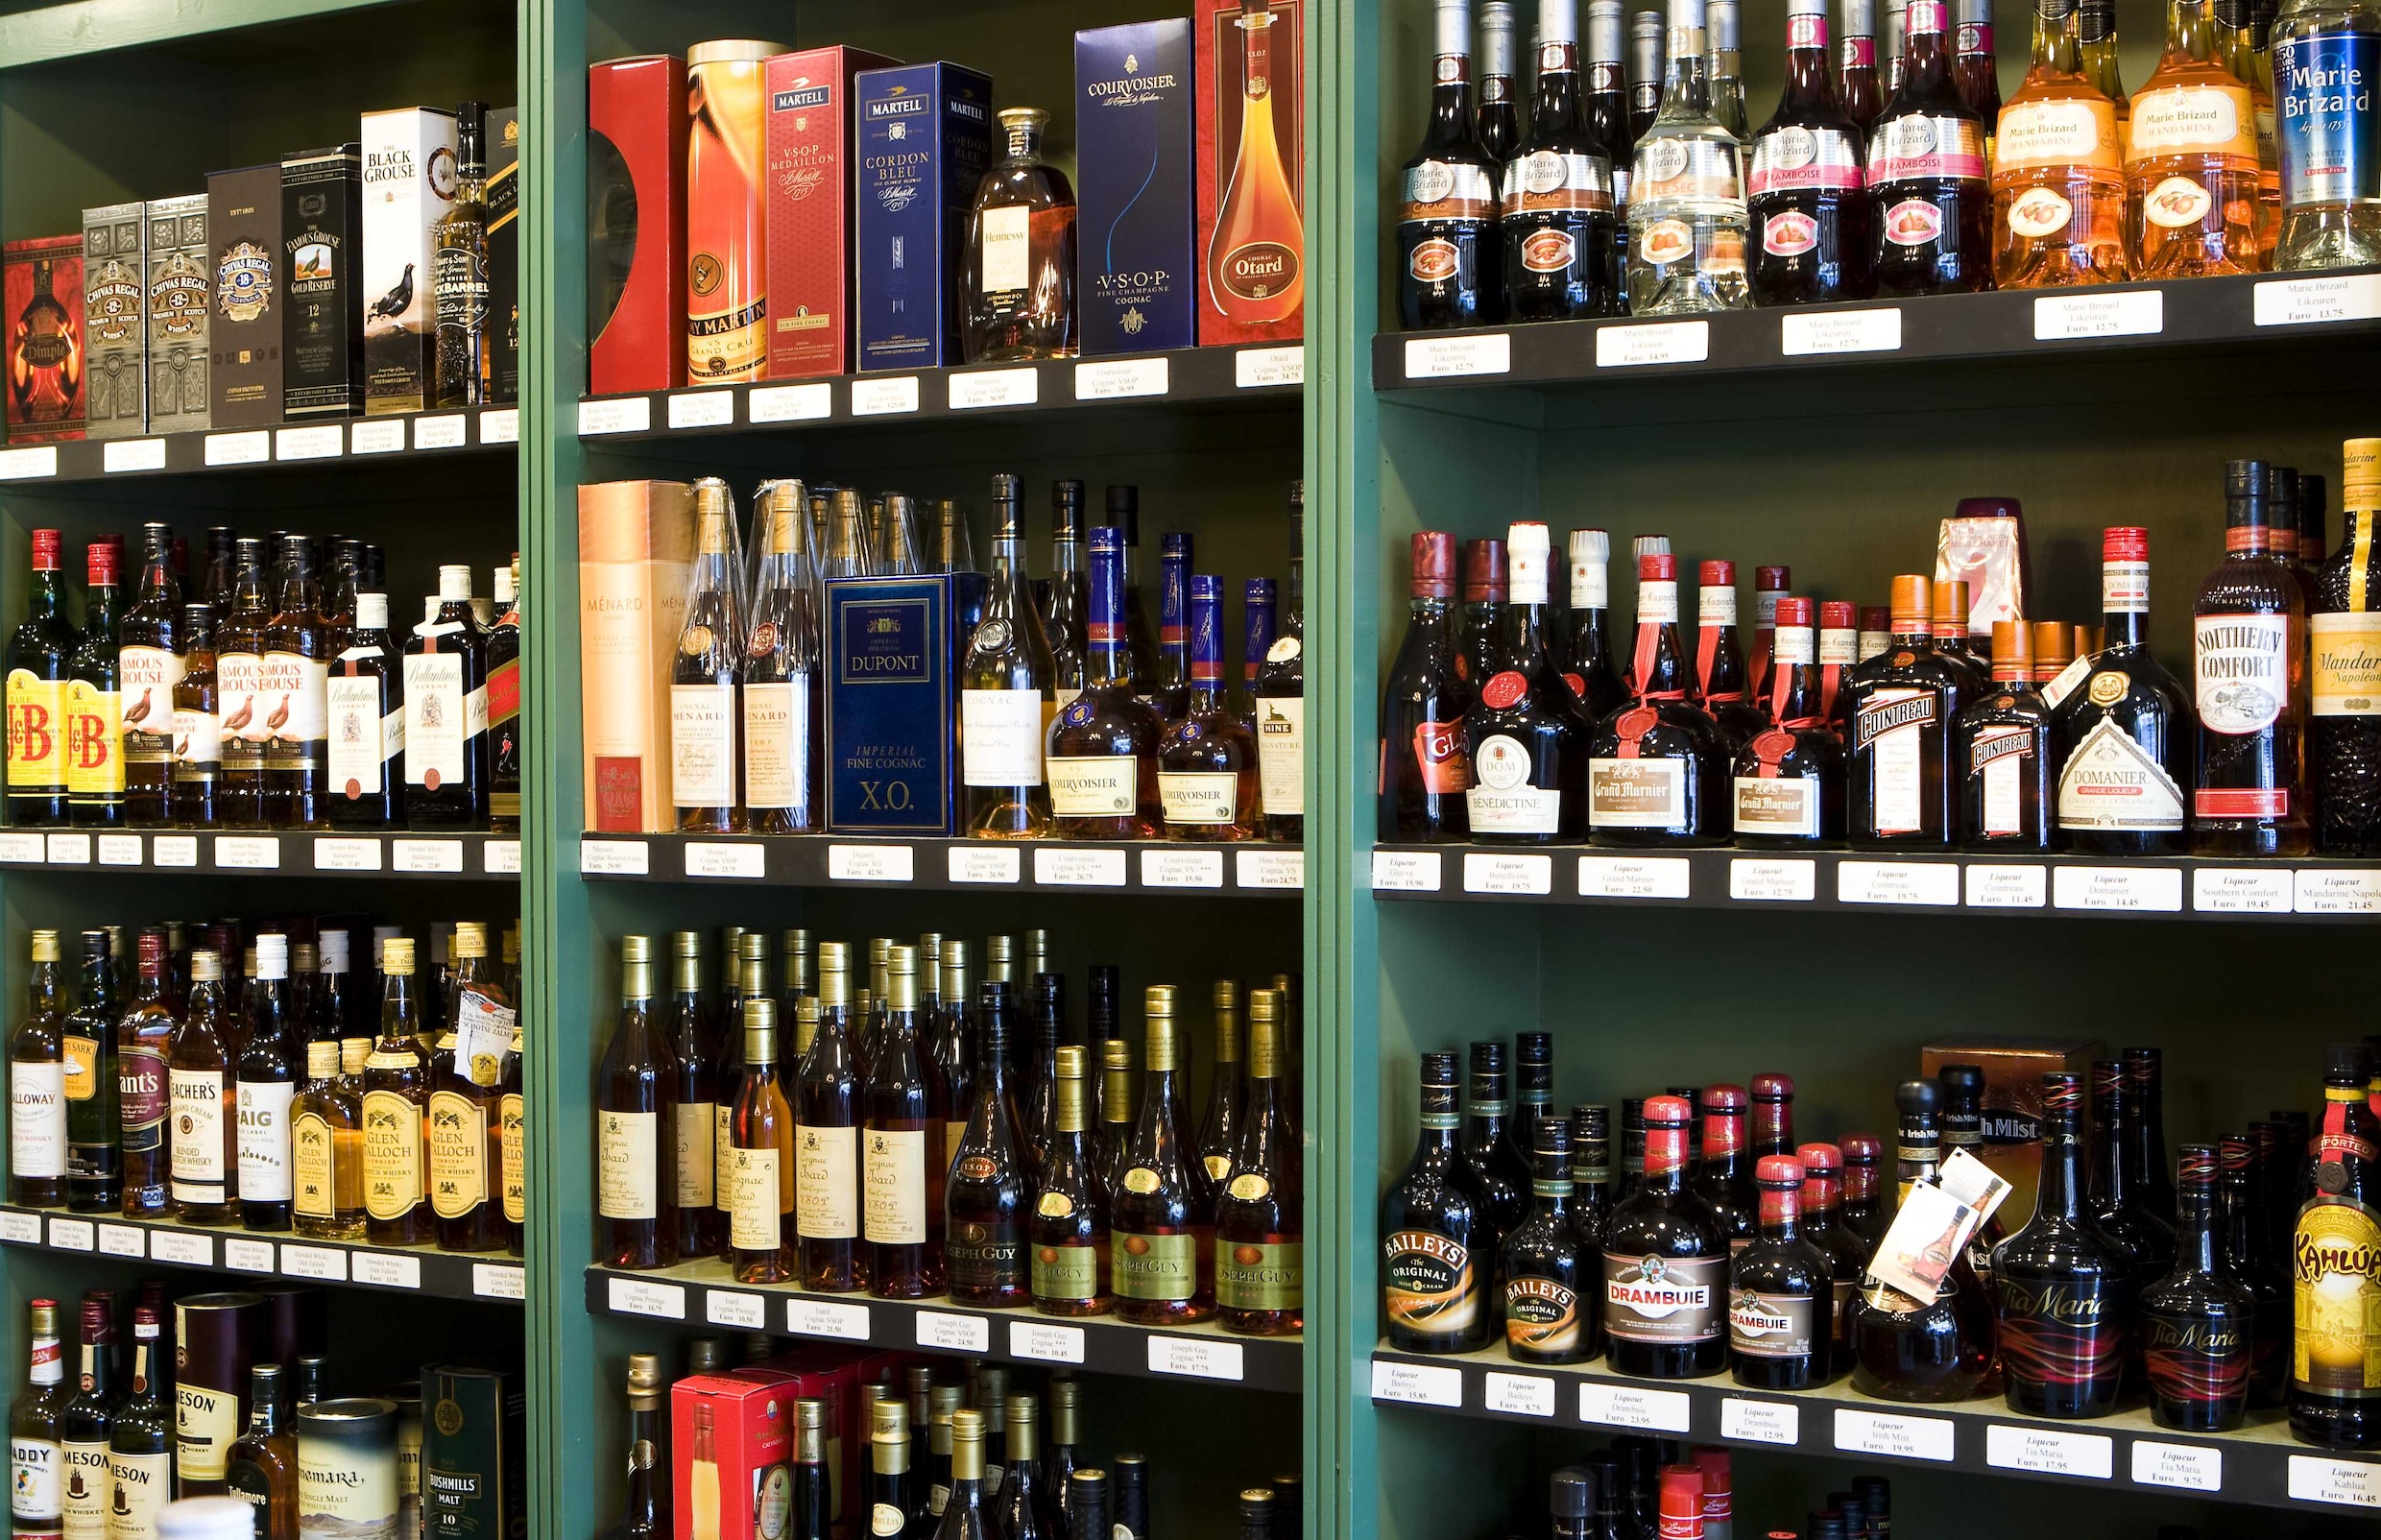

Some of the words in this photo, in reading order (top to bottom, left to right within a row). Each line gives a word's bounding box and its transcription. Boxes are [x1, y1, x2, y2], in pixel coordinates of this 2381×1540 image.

[2274, 46, 2295, 60] 250
[2291, 63, 2361, 89] Marie
[1088, 75, 1176, 98] COURVOISIER
[779, 92, 824, 108] MARTELL
[2284, 90, 2369, 119] Brizard
[873, 99, 922, 115] MARTELL
[950, 102, 983, 120] MARTELL
[2147, 111, 2174, 124] Marie
[2177, 109, 2217, 121] Brizard
[2010, 126, 2034, 136] Marie
[2038, 123, 2077, 133] Brizard
[2148, 123, 2213, 136] MANDARINE
[1776, 133, 1805, 145] Marie
[2010, 136, 2074, 149] MANDARINE
[1772, 144, 1810, 156] Brizard
[2305, 149, 2347, 158] ANISETTE
[369, 151, 410, 167] BLACK
[771, 155, 834, 171] MEDAILLON
[866, 152, 928, 169] CORDON
[1528, 158, 1557, 169] Marie
[1884, 158, 1942, 171] FRAMBOISE
[2307, 157, 2345, 166] LIQUEUR
[365, 164, 415, 182] GROUSE
[879, 166, 916, 180] BLEU
[1417, 169, 1444, 179] Marie
[1525, 168, 1560, 180] Brizard
[1765, 169, 1820, 181] FRAMBOISE
[1413, 179, 1447, 190] Brizard
[1525, 193, 1561, 204] CACAO
[1413, 204, 1448, 213] CACAO
[287, 233, 313, 253] FAMOUS
[314, 230, 340, 249] GROUSE
[985, 230, 1024, 244] Hennessy
[220, 260, 244, 276] CHIVAS
[247, 259, 270, 272] REGAL
[1237, 256, 1283, 276] Otard
[240, 274, 250, 284] 18
[151, 279, 179, 297] CHIVAS
[180, 277, 206, 292] REGAL
[291, 281, 308, 294] GOLD
[308, 279, 336, 293] RESERVE
[1118, 286, 1169, 296] CHAMPAGNE
[2288, 282, 2313, 293] Marie
[2317, 280, 2348, 291] Brizard
[87, 287, 113, 304] CHIVAS
[115, 285, 139, 299] REGAL
[1116, 296, 1151, 304] COGNAC
[2297, 295, 2336, 306] Likeuren
[308, 304, 319, 316] 12
[2289, 310, 2311, 321] Euro
[2320, 308, 2344, 320] 13.75
[708, 301, 766, 334] MARTIN
[805, 318, 827, 326] COGNAC
[103, 329, 125, 339] WHISKY
[167, 324, 191, 333] WHISKY
[28, 343, 64, 360] Dimple
[691, 347, 722, 356] GRAND
[727, 338, 753, 352] CRU
[588, 596, 642, 612] MÉNARD
[2198, 626, 2281, 656] SOUTHERN
[853, 656, 919, 671] DUPONT
[2202, 656, 2273, 678] COMFORT
[406, 661, 460, 683] Ballantine's
[329, 683, 376, 703] Ballantine's
[1861, 699, 1932, 741] COINTREAU
[8, 705, 51, 760] J&B
[856, 745, 916, 756] IMPERIAL
[1974, 734, 2031, 766] COINTREAU
[847, 758, 872, 768] FINE
[876, 758, 926, 768] COGNAC
[2074, 770, 2147, 784] DOMANIER
[1052, 779, 1117, 795] COURVOISIER
[1595, 782, 1620, 797] Grand
[1621, 782, 1668, 797] Marnier
[859, 781, 914, 810] X.O.
[1164, 790, 1220, 803] COURVOISIER
[1473, 796, 1541, 809] BÉNÉDICTINE
[1390, 859, 1416, 868] Liqueur
[1614, 865, 1642, 874] Liqueur
[2224, 878, 2257, 886] Liqueur
[2202, 888, 2240, 897] Southern
[72, 1044, 92, 1054] SARK
[190, 1107, 213, 1119] CREAM
[1996, 1119, 2037, 1138] Mist
[368, 1134, 399, 1143] GLEN
[434, 1134, 462, 1143] GLEN
[177, 1147, 200, 1156] BLENDED
[301, 1148, 321, 1157] GLEN
[364, 1147, 411, 1157] TALLOCH
[189, 1156, 212, 1166] WHISKY
[298, 1157, 326, 1167] TALLOCH
[982, 1247, 1015, 1261] GUY
[1385, 1233, 1465, 1271] BAILEYS
[2295, 1230, 2381, 1283] KAHLÚA
[1056, 1266, 1084, 1279] GUY
[1148, 1261, 1180, 1274] GUY
[1260, 1270, 1295, 1284] GUY
[1392, 1267, 1448, 1282] ORIGINAL
[1507, 1283, 1574, 1306] BAILEYS
[1611, 1285, 1705, 1306] DRAMBUIE
[1514, 1305, 1557, 1317] ORIGINAL
[1171, 1343, 1192, 1353] Joseph
[1194, 1345, 1209, 1355] Guy
[1192, 1363, 1209, 1372] 17.75
[1391, 1369, 1418, 1380] Liqueur
[1391, 1379, 1416, 1389] Baileys
[1383, 1388, 1401, 1398] Euro
[1408, 1391, 1427, 1400] 15.85
[1614, 1393, 1643, 1405] Liqueur
[1612, 1403, 1647, 1414] Drambuie
[1605, 1413, 1624, 1423] Euro
[1630, 1416, 1650, 1426] 23.95
[2027, 1435, 2059, 1449] Liqueur
[2025, 1446, 2036, 1456] Tia
[2038, 1448, 2063, 1459] Maria
[2017, 1456, 2038, 1468] Euro
[2046, 1460, 2068, 1471] 17.95
[2331, 1466, 2368, 1480] Liqueur
[429, 1474, 475, 1491] BUSHMILLS
[2334, 1478, 2366, 1491] Kahlua
[304, 1494, 325, 1503] SINGLE
[438, 1494, 460, 1504] MALT
[2321, 1489, 2345, 1501] Euro
[2353, 1492, 2377, 1504] 16.45
[442, 1514, 455, 1525] 10
